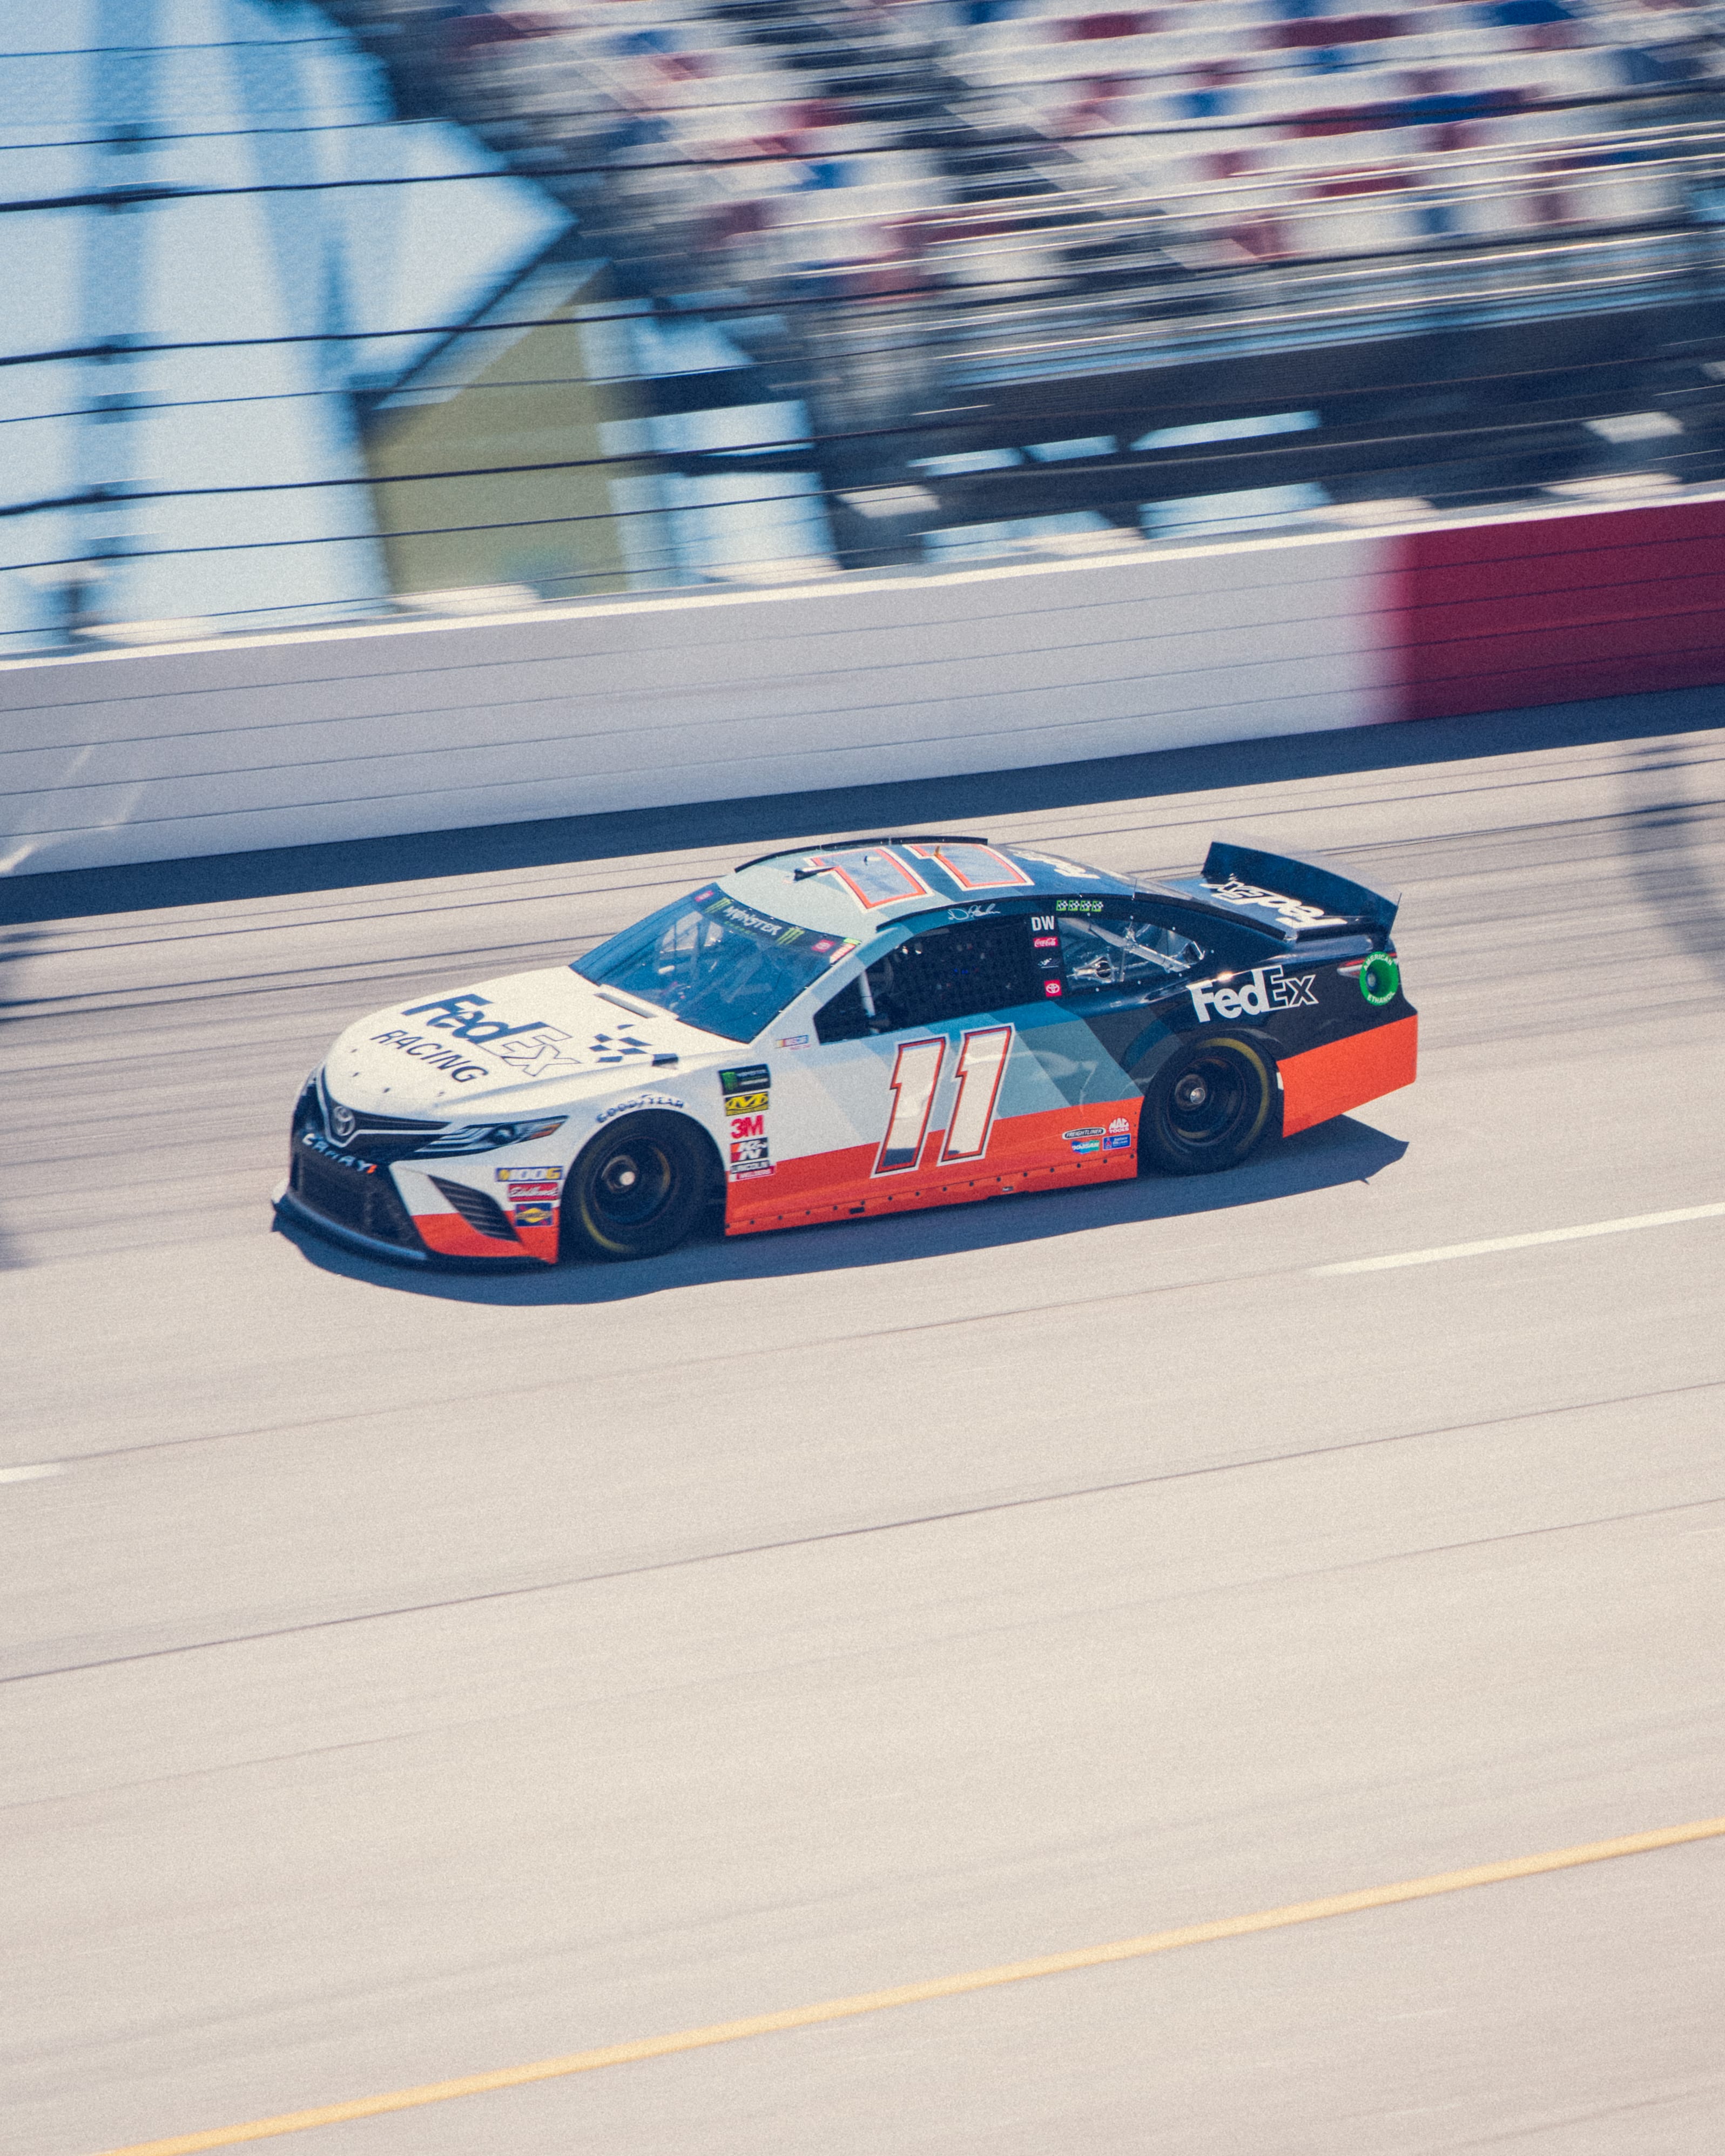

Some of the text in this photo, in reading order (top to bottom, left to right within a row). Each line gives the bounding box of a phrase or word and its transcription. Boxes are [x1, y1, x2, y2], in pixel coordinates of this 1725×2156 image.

[803, 843, 1035, 914] 11
[722, 905, 783, 936] MONSTER
[1031, 916, 1055, 932] DW
[1363, 954, 1393, 971] AMERICAN
[1185, 965, 1319, 1023] FedEx
[1367, 991, 1396, 1004] ETHANOL
[401, 994, 582, 1076] FedEx
[369, 1029, 489, 1083] RACING
[596, 1094, 684, 1123] GOODYEAR
[870, 1022, 1015, 1178] 11
[731, 1115, 764, 1139] 3M
[1066, 1128, 1103, 1138] FREIGHTLINER
